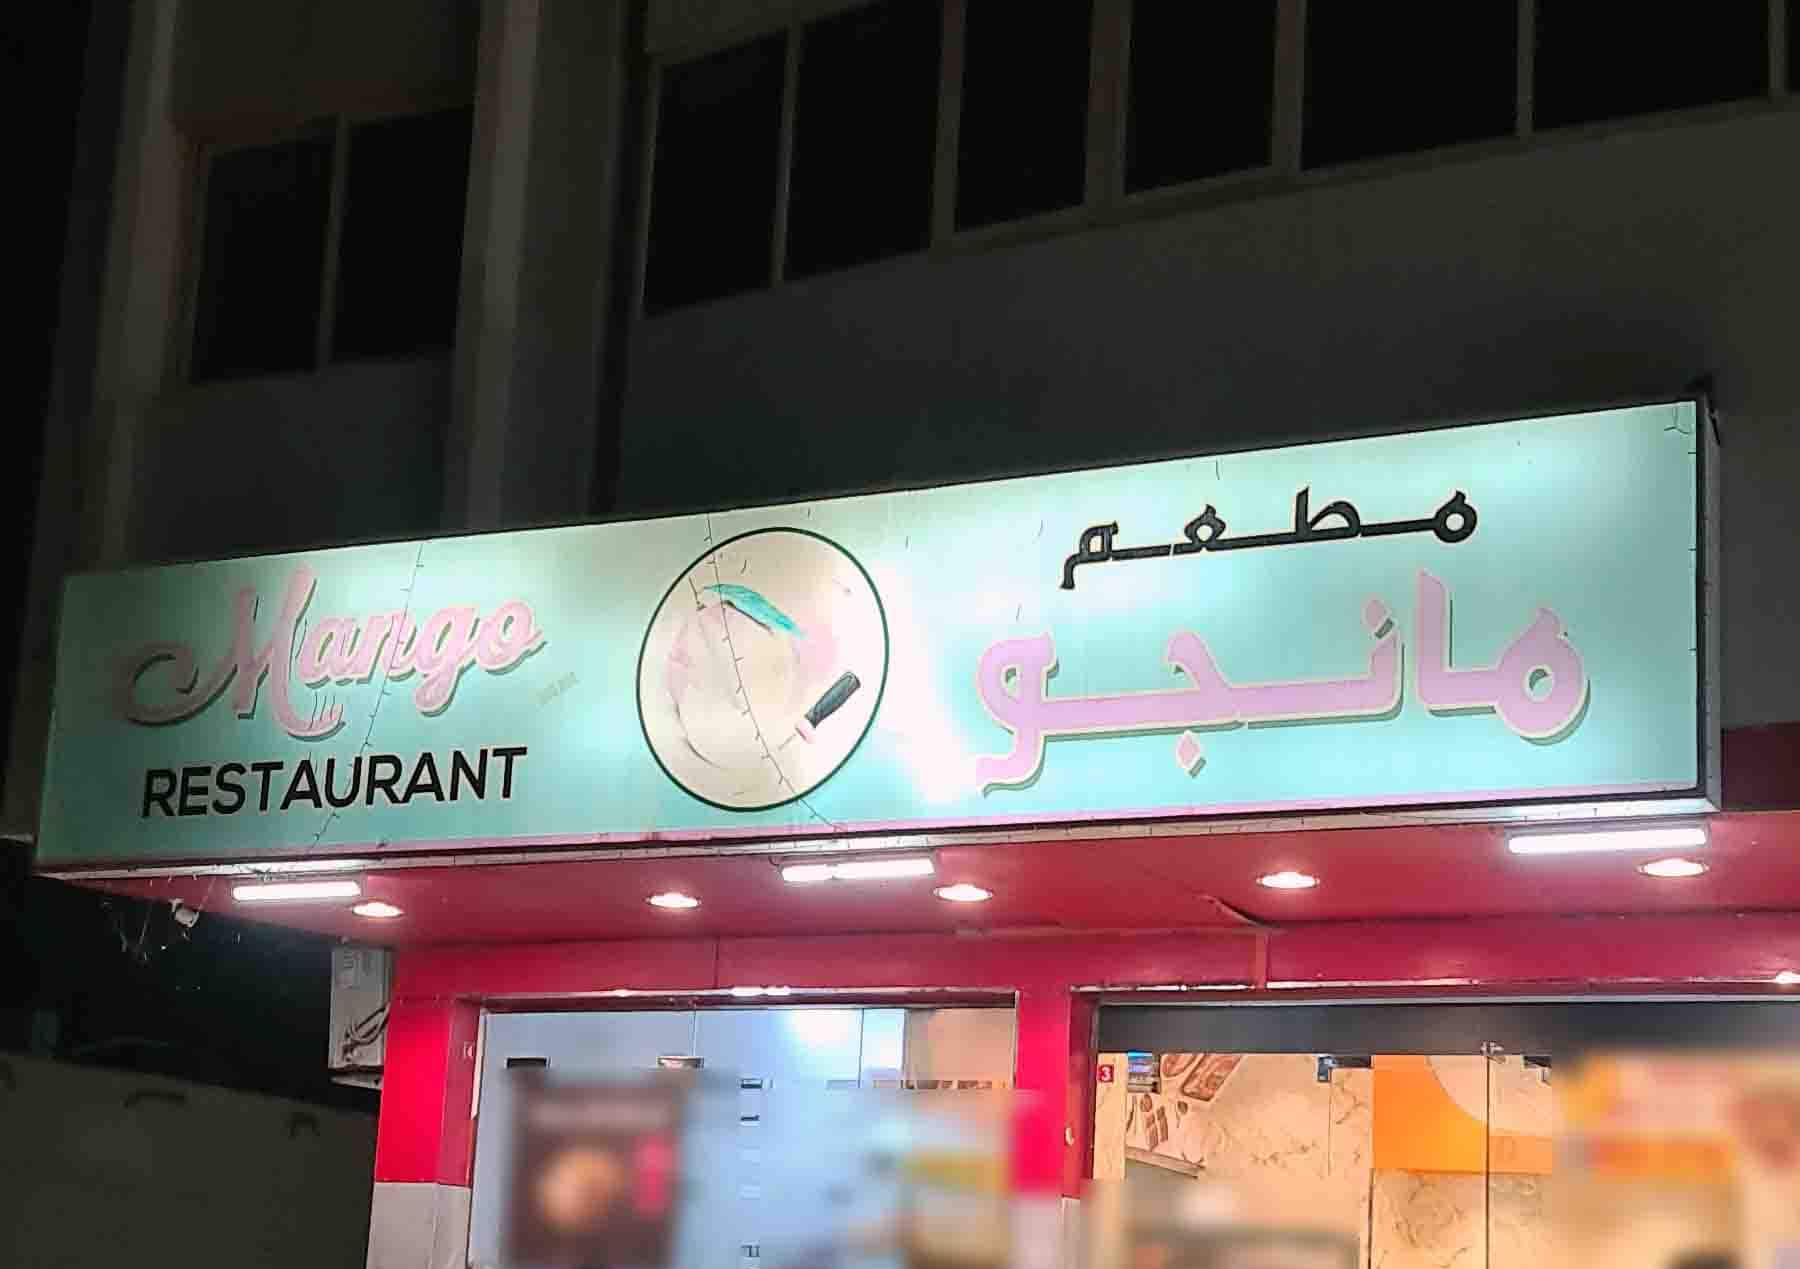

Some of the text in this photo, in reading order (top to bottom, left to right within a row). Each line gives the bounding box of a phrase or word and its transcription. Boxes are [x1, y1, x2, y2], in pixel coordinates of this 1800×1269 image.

[1060, 487, 1478, 589] مطعم
[119, 565, 547, 741] Mango
[976, 570, 1590, 796] مانجو
[141, 747, 527, 818] RESTAURANT
